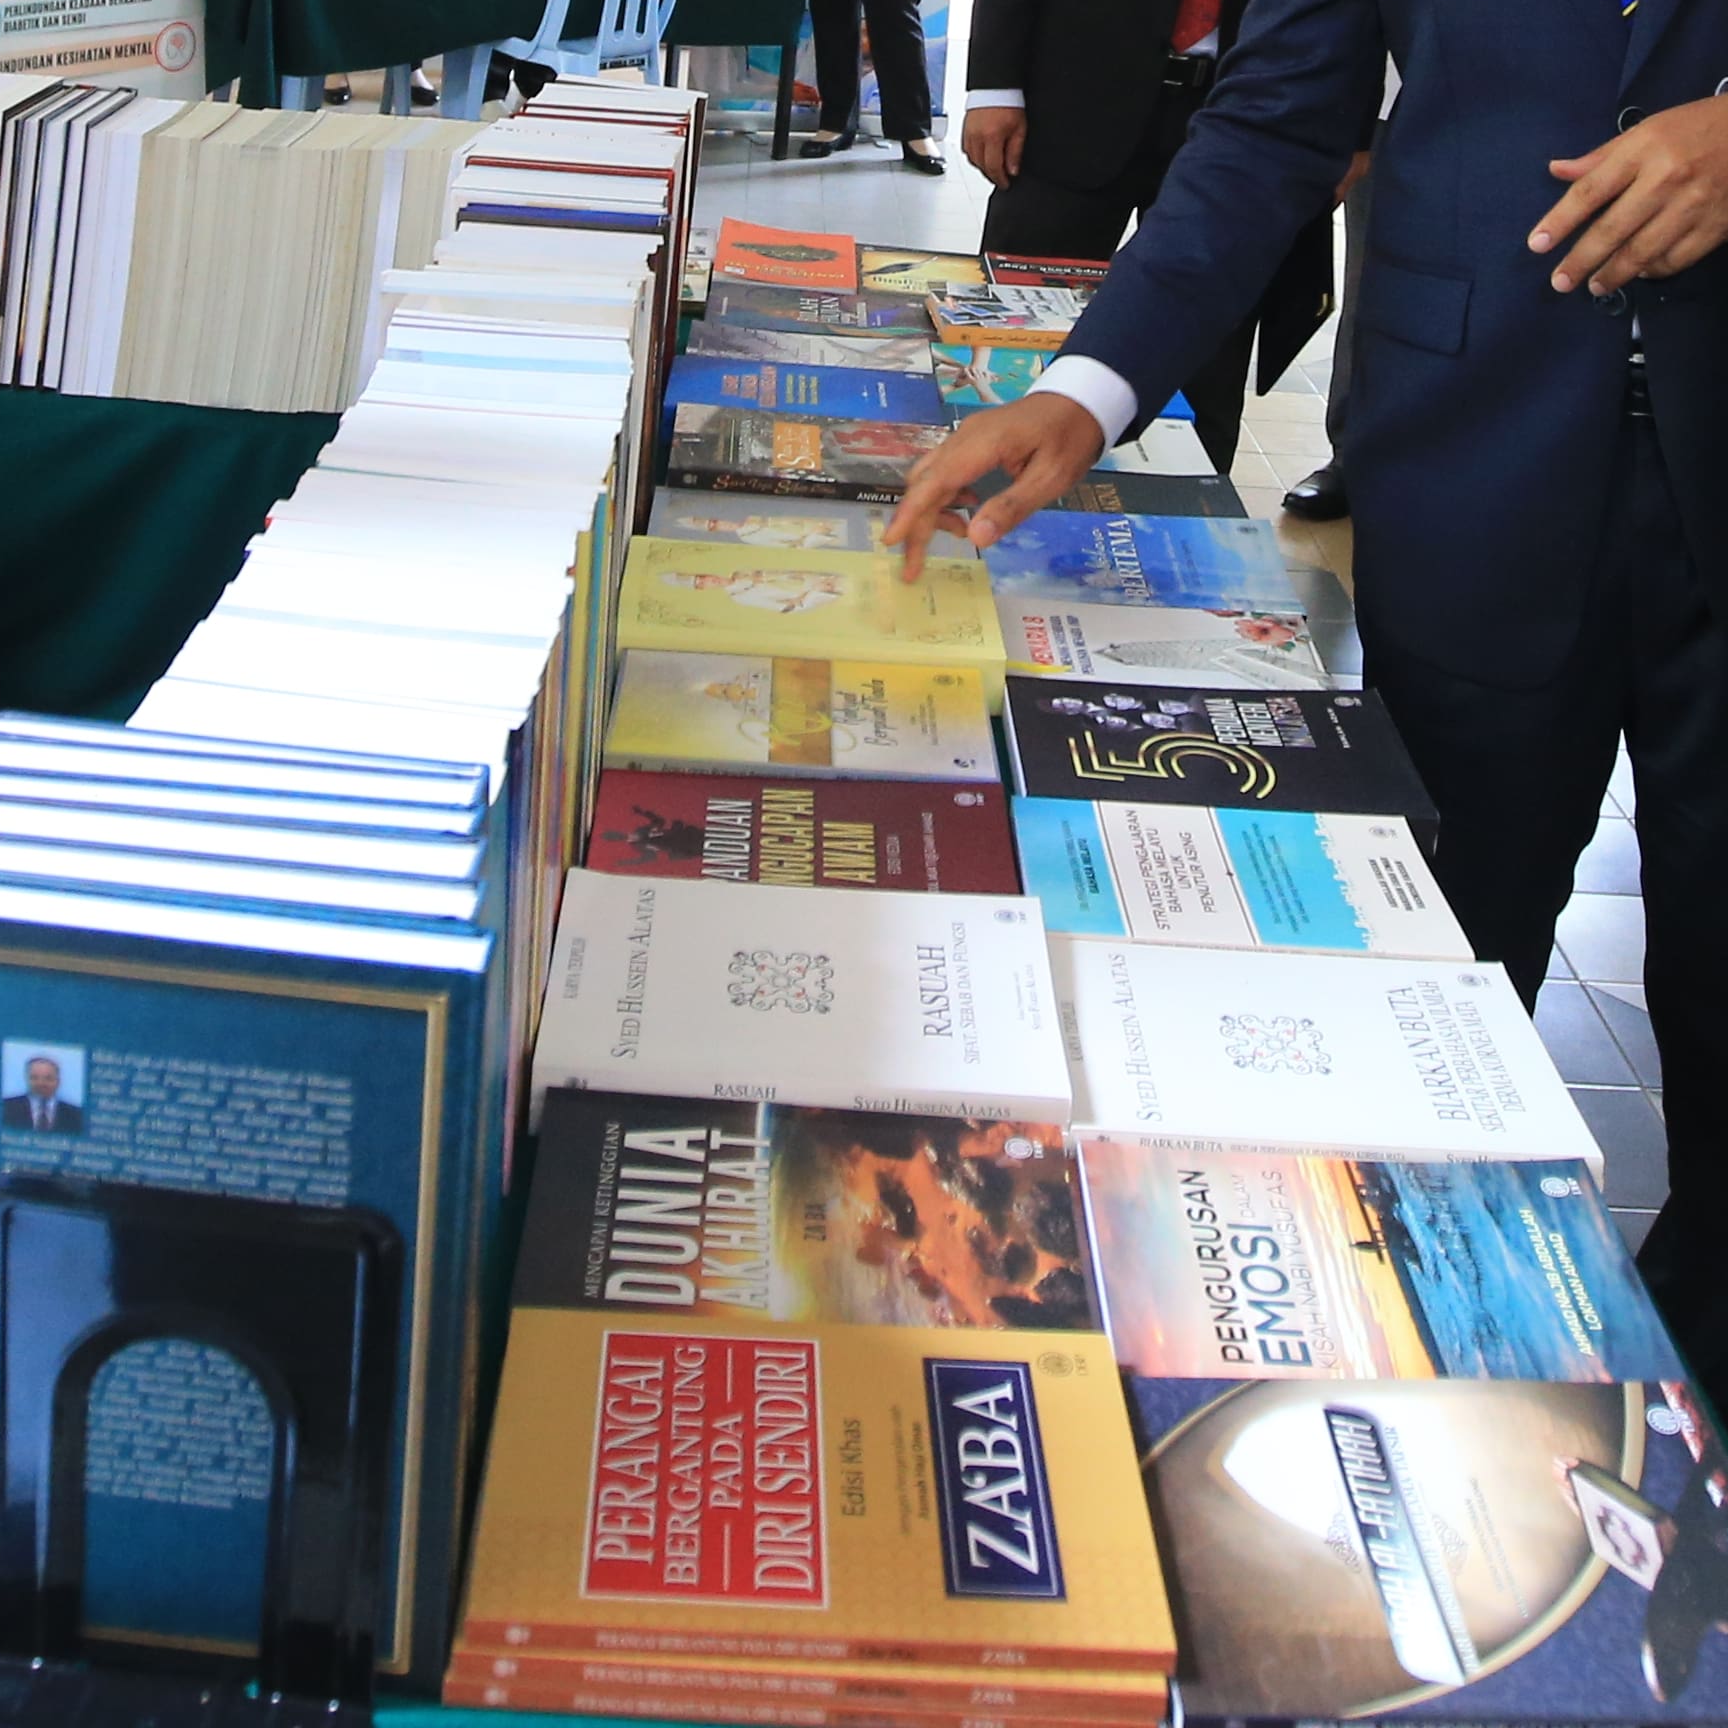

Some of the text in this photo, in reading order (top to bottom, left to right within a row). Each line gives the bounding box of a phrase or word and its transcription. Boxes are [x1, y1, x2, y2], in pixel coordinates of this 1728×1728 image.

[4, 2, 66, 17] PERLINDUNGAN
[857, 491, 891, 503] ANWAR
[1204, 698, 1250, 745] PERDANA
[1239, 702, 1283, 747] MENTERI
[701, 798, 752, 881] ANDUAN
[822, 822, 876, 883] AWAM
[1126, 809, 1171, 930] STRATEGI PENGAJARAN
[1146, 828, 1182, 913] BAHASA MELAYU
[1171, 856, 1192, 889] UNTUK
[1179, 832, 1216, 913] PENUTUR ASING
[611, 888, 655, 1059] SYED HUSSEIN ALATAS
[916, 945, 953, 1037] RASUAH
[951, 922, 981, 1065] SIFAT, SEBAB DAN FUNGSI
[1108, 953, 1163, 1122] SYED HUSSEIN ALATAS
[1385, 987, 1472, 1121] BIARKAN BUTA
[713, 1083, 1011, 1118] RASUAH SYED HUSSEIN ALATAS
[584, 1122, 621, 1299] MENCAPAI KETINGGIAN
[604, 1126, 709, 1307] DUNIA
[699, 1128, 771, 1309] AKHIRAT
[1232, 1174, 1256, 1218] DALAM
[1178, 1169, 1254, 1364] PENGURUSAN
[1226, 1223, 1312, 1367] EMOSI
[1262, 1169, 1340, 1370] KISAH NABI YUSUF AS
[1519, 1208, 1594, 1357] AHMAD NAJIB ABDULLAH
[1549, 1232, 1603, 1331] LOKMAN AHMAD
[593, 1356, 666, 1565] PERANGAI
[664, 1344, 707, 1586] BERGANTUNG
[709, 1413, 745, 1510] PADA
[754, 1348, 815, 1592] DIRI SENDIRI
[838, 1419, 866, 1517] Edisi Khas
